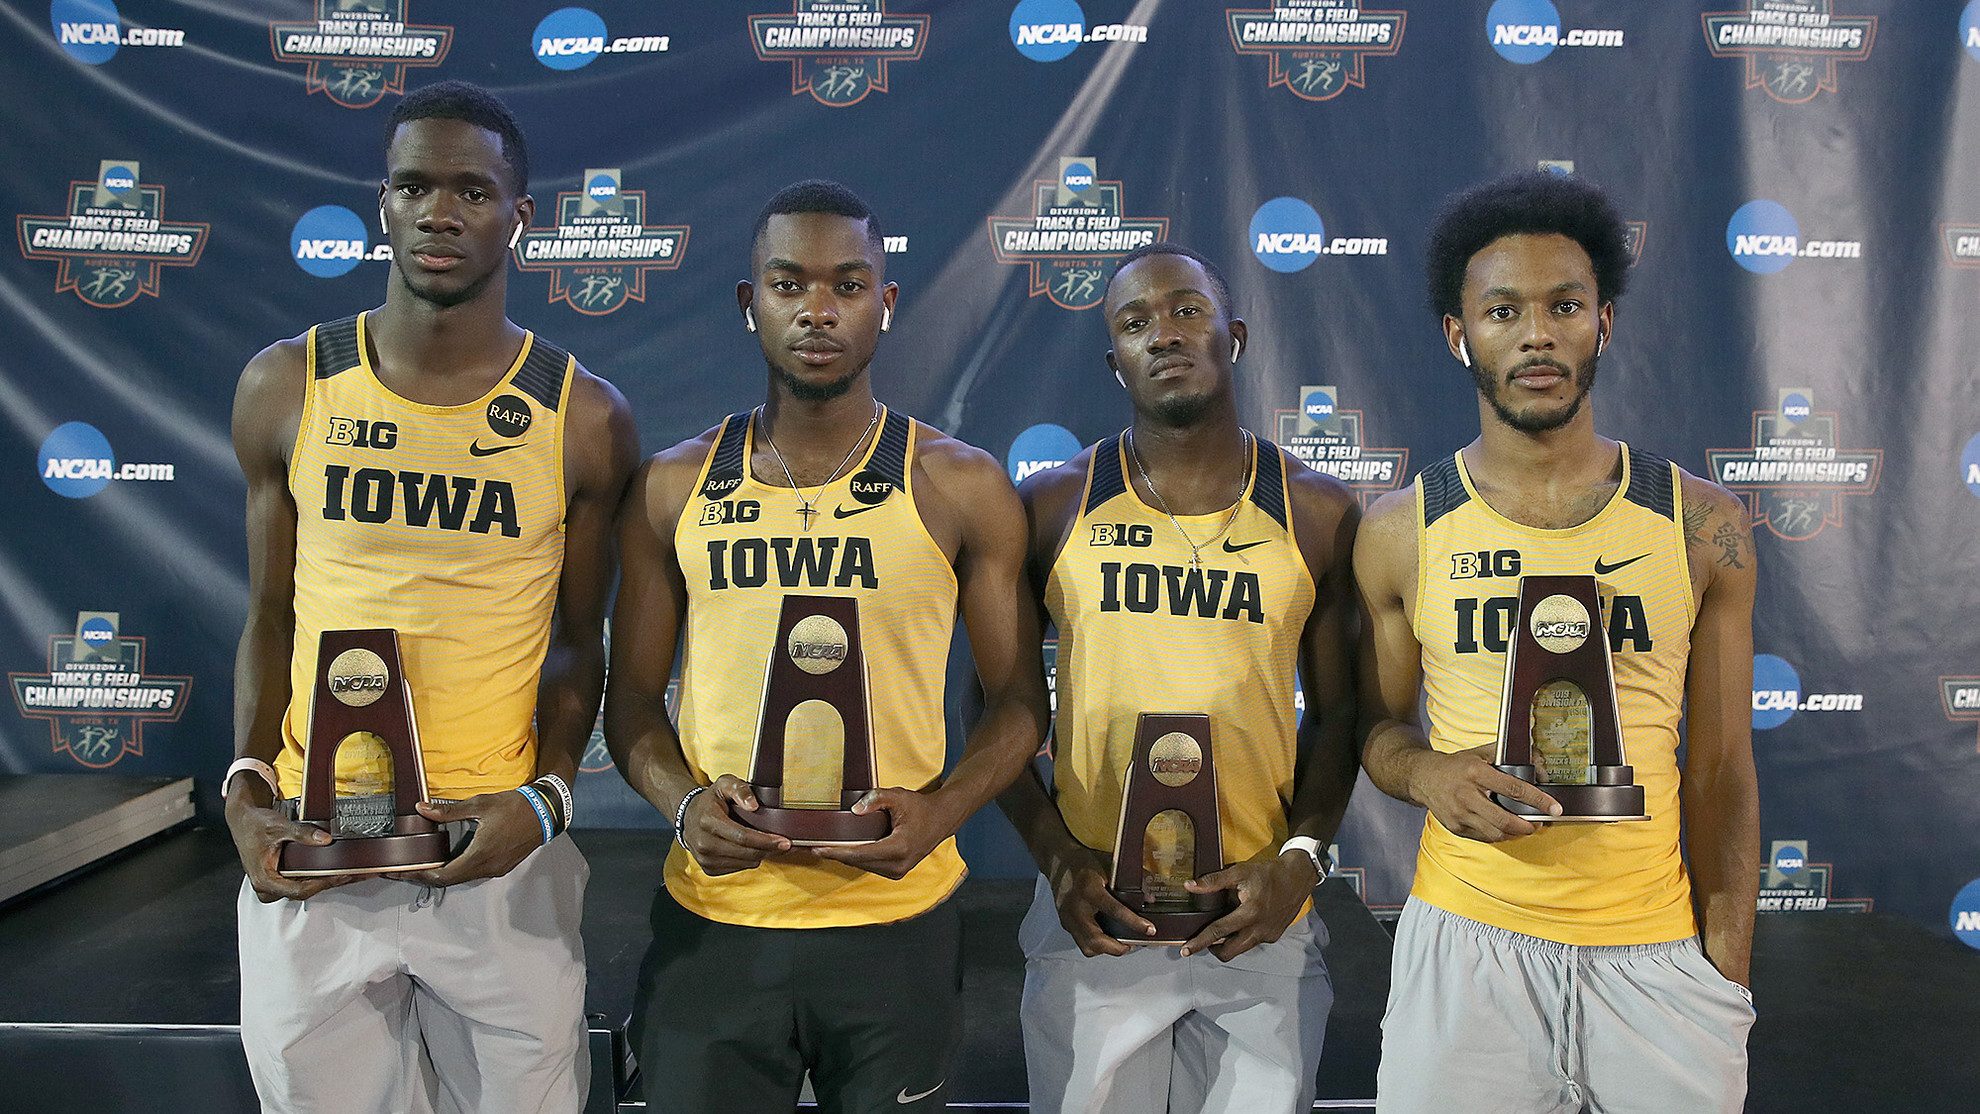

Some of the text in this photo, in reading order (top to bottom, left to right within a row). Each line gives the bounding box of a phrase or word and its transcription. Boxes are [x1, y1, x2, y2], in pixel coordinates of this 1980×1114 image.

[797, 13, 882, 26] TRACK & FIELD
[1274, 8, 1358, 21] TRACK & FIELD
[1751, 11, 1829, 27] TRACK & FIELD
[61, 22, 186, 46] NCAA.com
[318, 20, 404, 36] TRACK & FIELD
[1017, 23, 1147, 45] NCAA.com
[1243, 22, 1391, 43] CHAMPIONSHIPS
[1494, 25, 1623, 46] NCAA.com
[1719, 24, 1862, 49] CHAMPIONSHIPS
[284, 35, 437, 57] CHAMPIONSHIPS
[538, 36, 670, 56] NCAA.com
[765, 27, 915, 48] CHAMPIONSHIPS
[105, 178, 134, 188] NCAA
[1066, 176, 1092, 186] NCAA
[590, 187, 616, 196] NCAA
[1049, 207, 1096, 216] DIVISION
[69, 215, 160, 232] TRACK & FIELD
[559, 225, 642, 238] TRACK & FIELD
[1035, 217, 1120, 230] TRACK & FIELD
[32, 229, 193, 254] CHAMPIONSHIPS
[526, 239, 674, 260] CHAMPIONSHIPS
[1004, 230, 1154, 251] CHAMPIONSHIPS
[1256, 233, 1388, 254] NCAA.com
[1734, 235, 1861, 258] NCAA.com
[297, 240, 394, 260] NCAA.c
[489, 404, 531, 429] RAFF
[1306, 405, 1333, 414] NCAA
[1784, 406, 1810, 416] NCAA
[1280, 446, 1316, 459] ACK
[1327, 446, 1360, 459] FIELD
[1755, 447, 1836, 461] TRACK & FIELD
[44, 458, 175, 480] NCAA.com
[1302, 461, 1393, 480] IONSHIPS
[1722, 462, 1868, 482] CHAMPIONSHIPS
[706, 478, 741, 491] RAFF
[852, 481, 892, 493] RAFF
[322, 464, 521, 538] IOWA
[707, 537, 878, 590] IOWA
[1100, 562, 1264, 624] IOWA
[1454, 596, 1653, 654] IOA
[1536, 621, 1587, 638] NCAA
[82, 631, 113, 640] NCAA
[792, 642, 844, 660] NCAA
[51, 672, 140, 687] TRACK & FIELD
[334, 676, 384, 692] NCAA
[25, 686, 175, 709] CHAMPIONSHIPS
[1752, 690, 1863, 711] CAA.com
[1777, 858, 1803, 868] NCAA
[1756, 898, 1782, 911] ACK
[1794, 898, 1827, 911] FIELD
